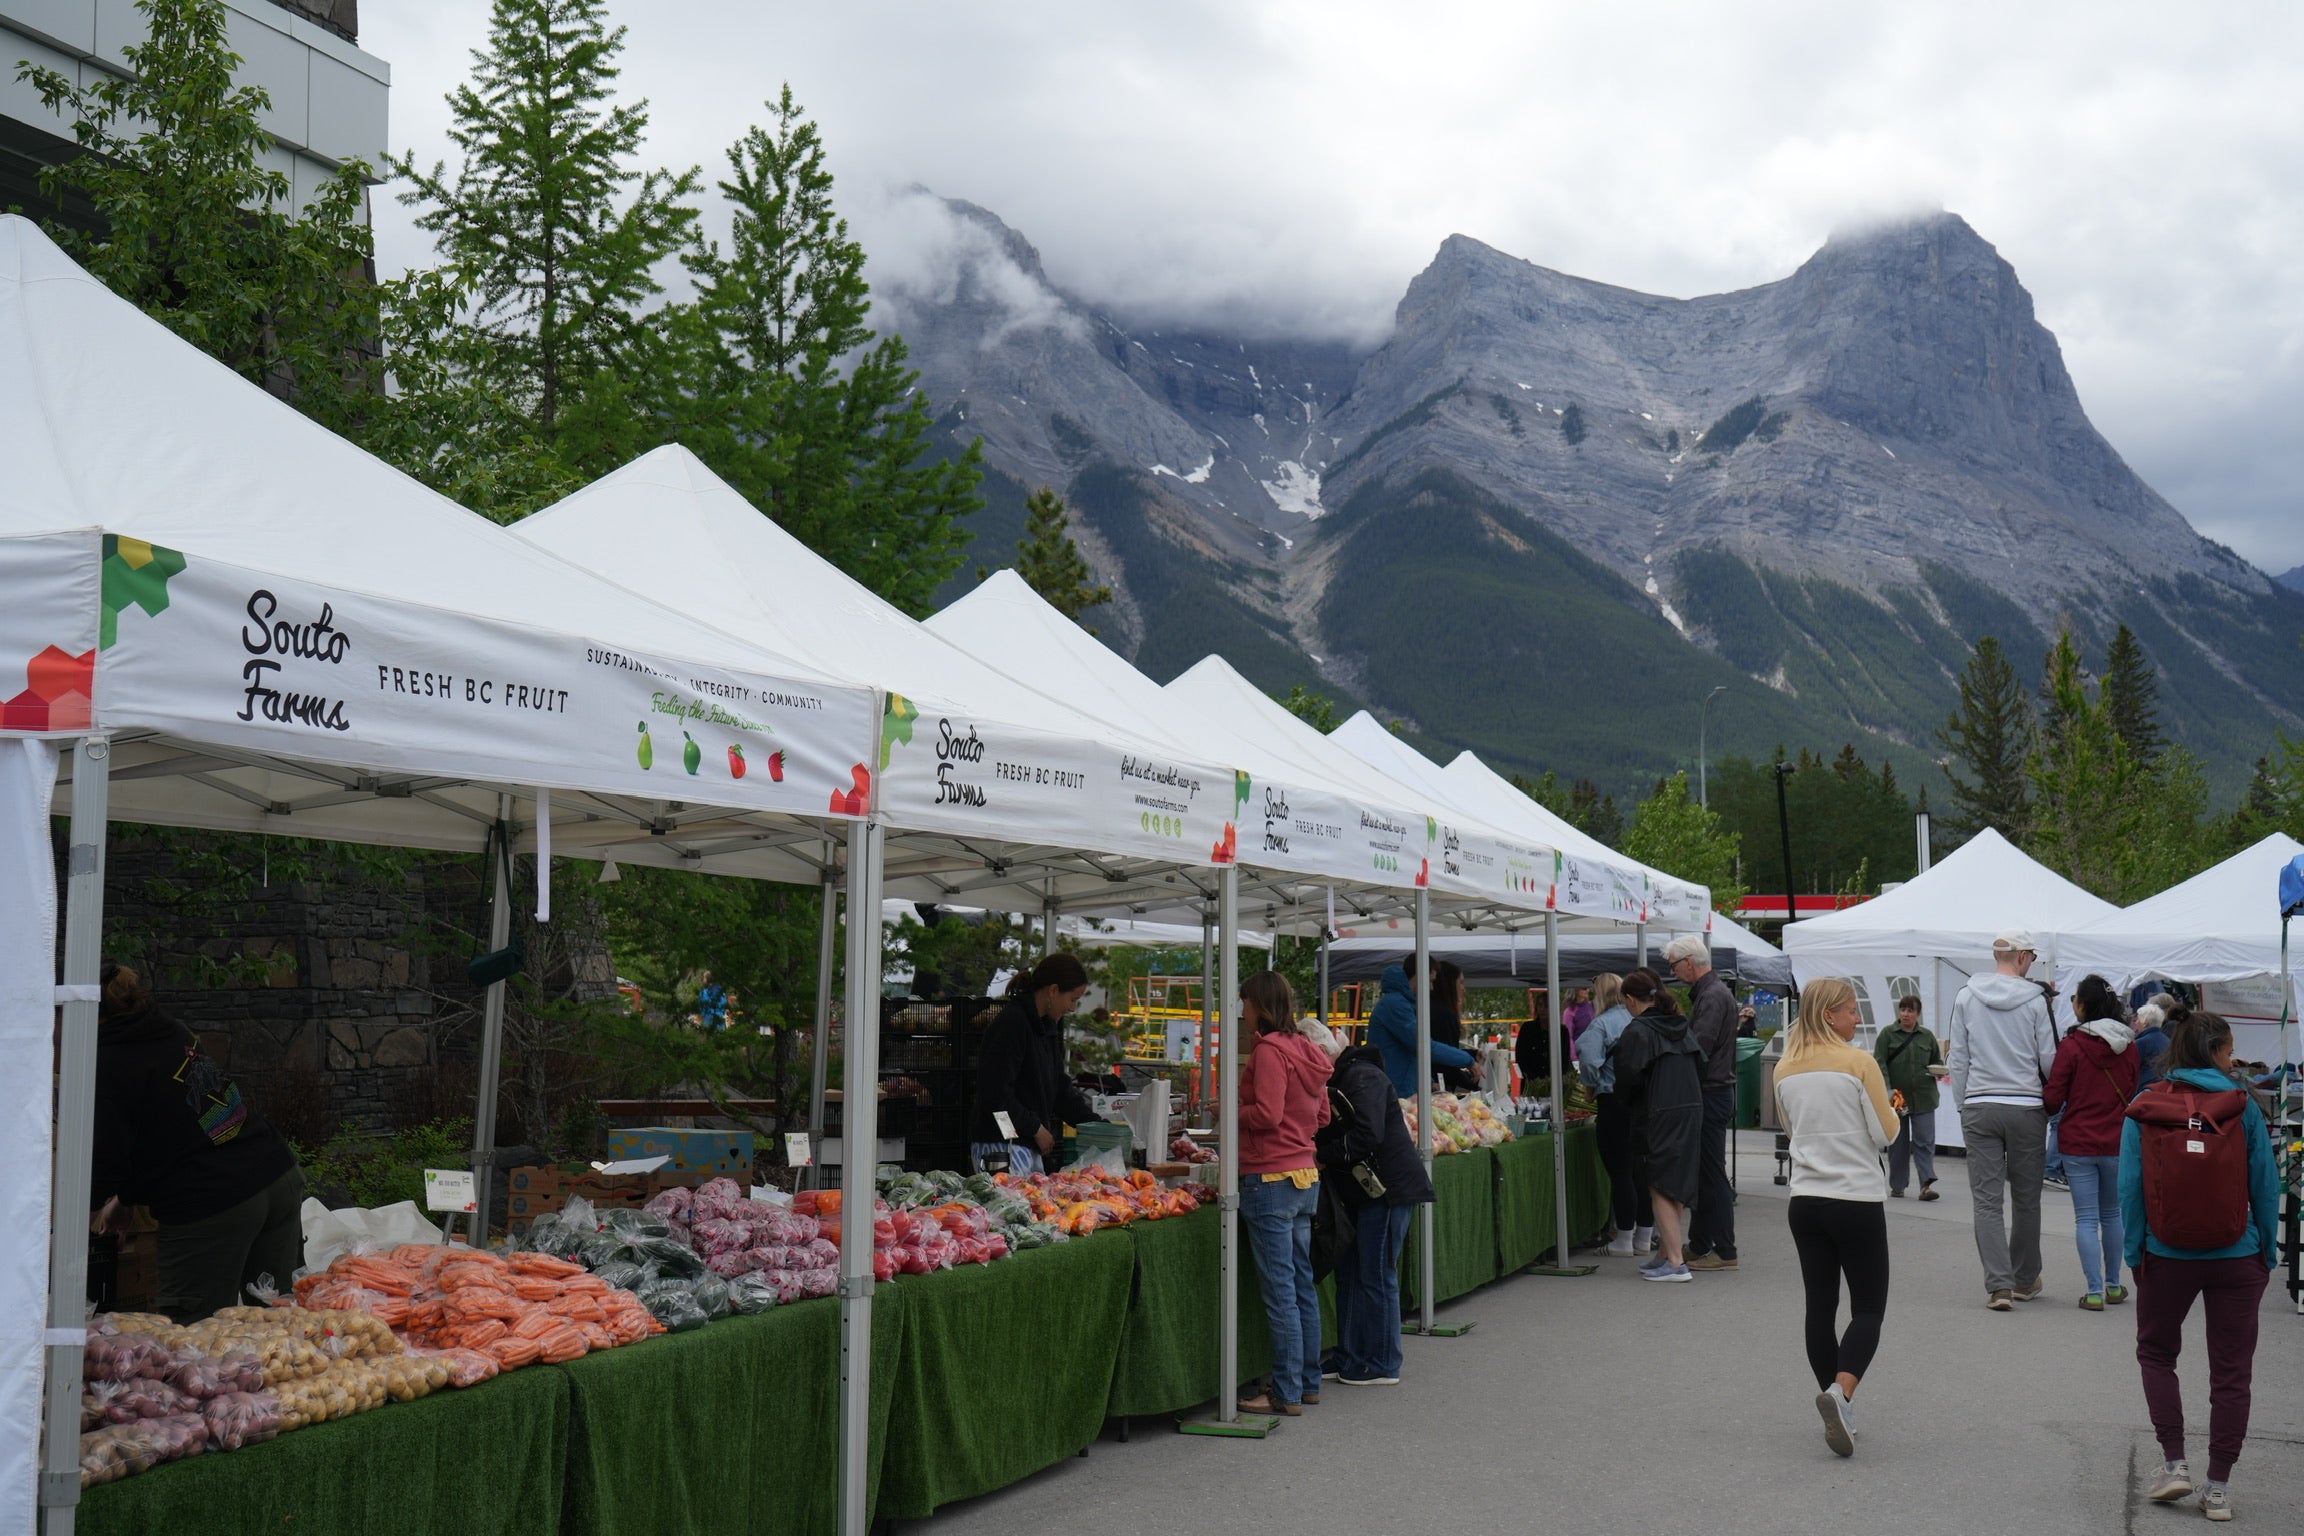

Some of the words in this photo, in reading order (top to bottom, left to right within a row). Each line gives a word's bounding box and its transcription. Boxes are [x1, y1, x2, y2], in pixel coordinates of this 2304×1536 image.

[242, 589, 351, 664] Souto
[236, 658, 350, 731] Farms
[378, 665, 452, 699] FRESH
[465, 678, 493, 704] BC
[505, 683, 568, 713] FRUIT
[690, 679, 750, 700] INTEGRITY
[761, 691, 823, 710] COMMUNITY
[651, 692, 687, 726] Feeding
[687, 699, 705, 720] the
[704, 703, 740, 726] Future
[936, 718, 985, 763] Souto
[935, 763, 987, 807] Farms
[996, 762, 1031, 782] FRESH
[1035, 768, 1050, 784] BC
[1054, 771, 1084, 789] FRUIT
[1121, 755, 1136, 780] find
[1135, 767, 1143, 779] us
[1143, 762, 1152, 780] at
[1157, 766, 1177, 786] market
[1178, 777, 1190, 789] near
[1190, 780, 1201, 799] you
[1135, 794, 1188, 813] www.soutofarms.com
[1264, 786, 1289, 820] Souto
[1263, 820, 1289, 854] Farms
[1296, 820, 1314, 834] FRESH
[1316, 823, 1324, 836] BC
[1325, 825, 1341, 839] FRUIT
